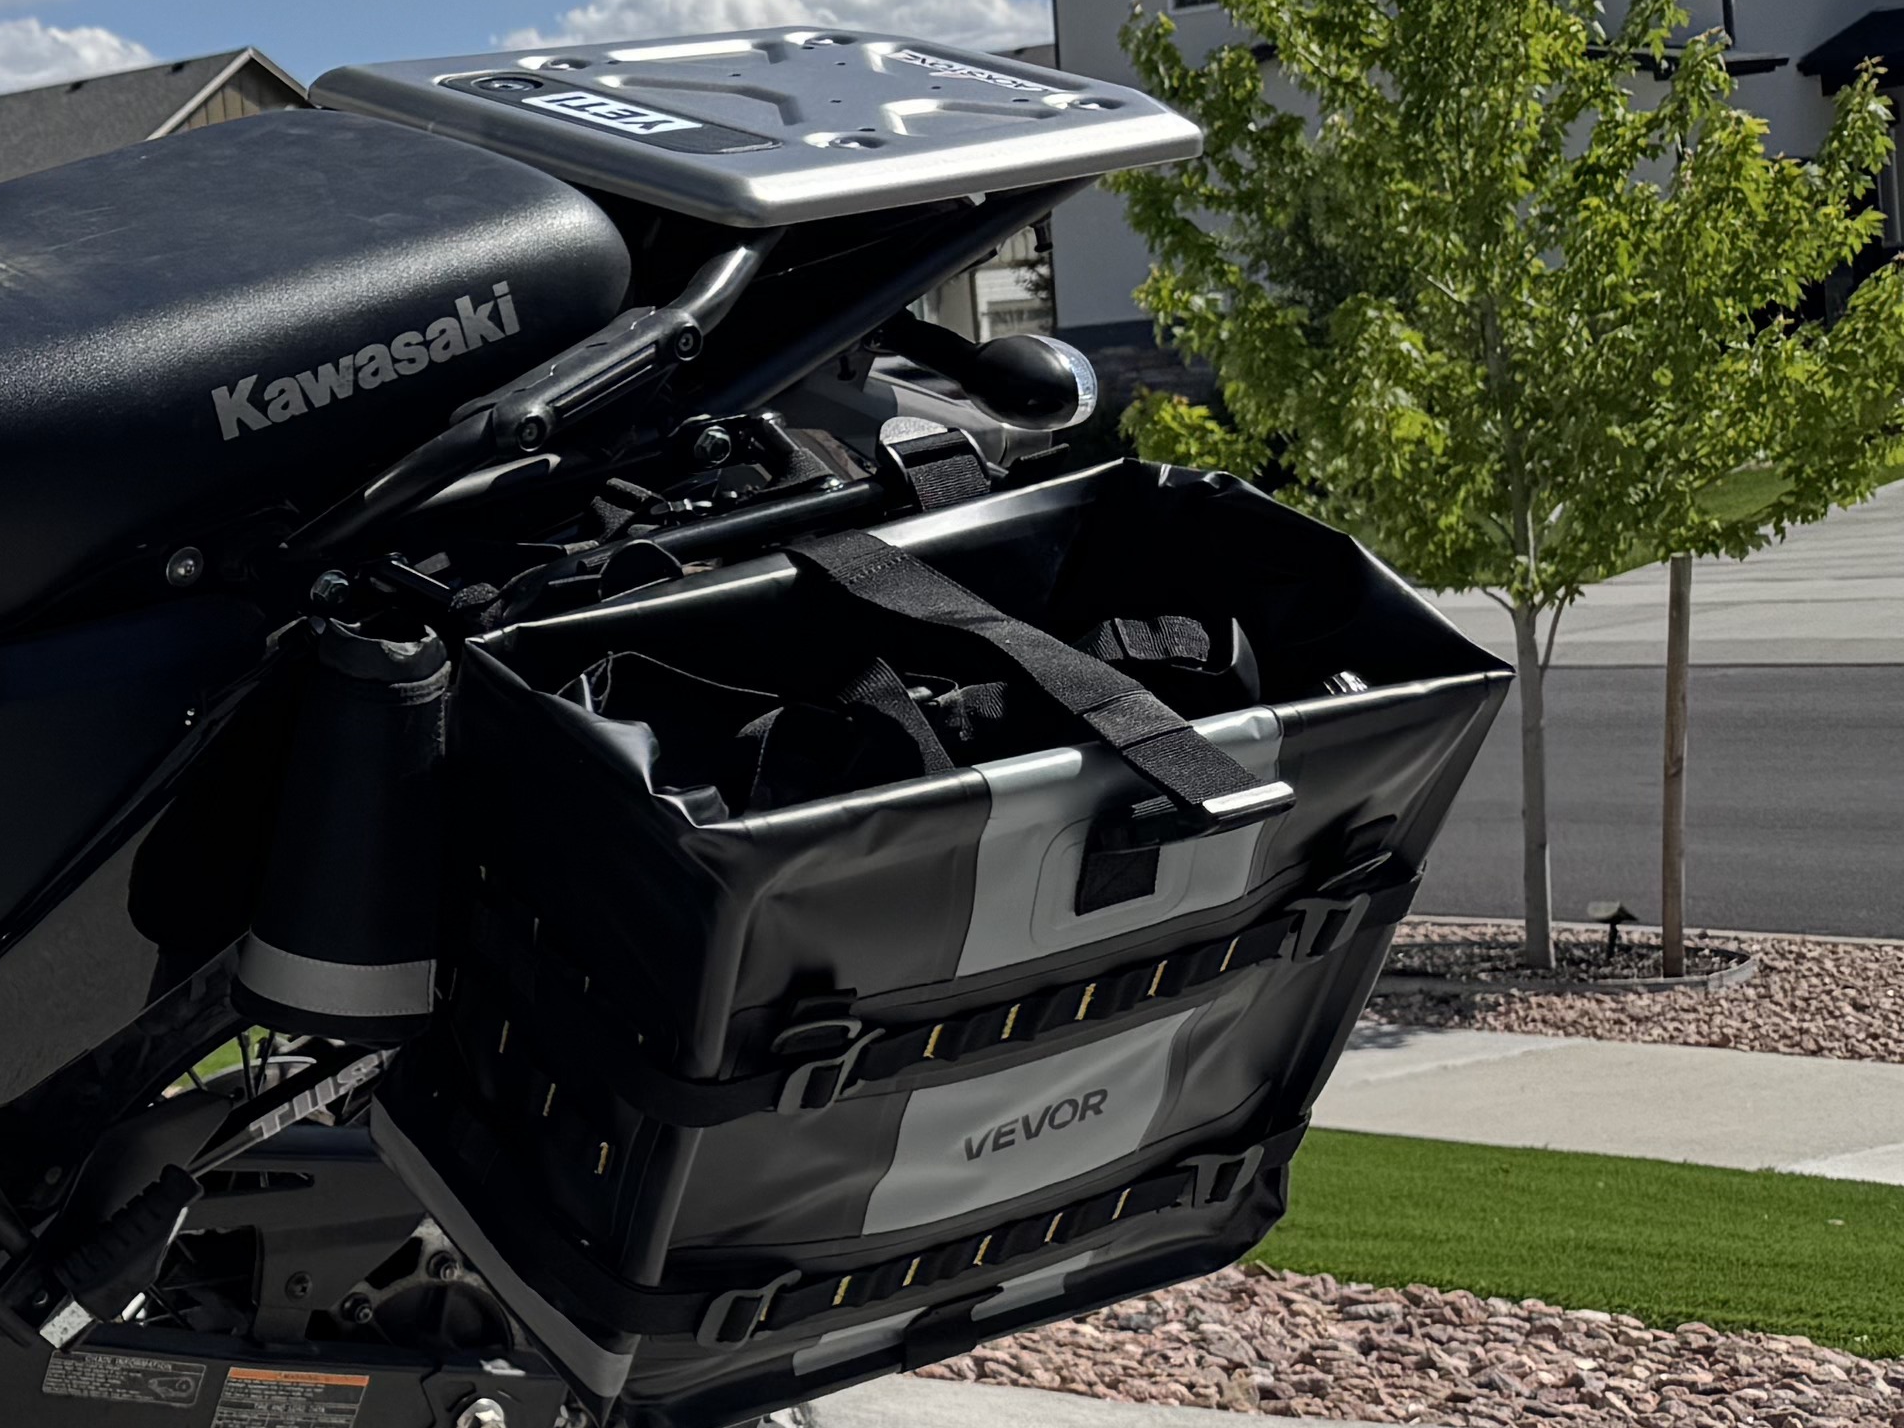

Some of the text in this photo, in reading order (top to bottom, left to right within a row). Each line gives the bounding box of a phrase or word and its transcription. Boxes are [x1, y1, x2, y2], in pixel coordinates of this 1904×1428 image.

[541, 96, 673, 131] YETI
[211, 280, 521, 441] Kawasaki
[964, 1088, 1109, 1162] VEVOR
